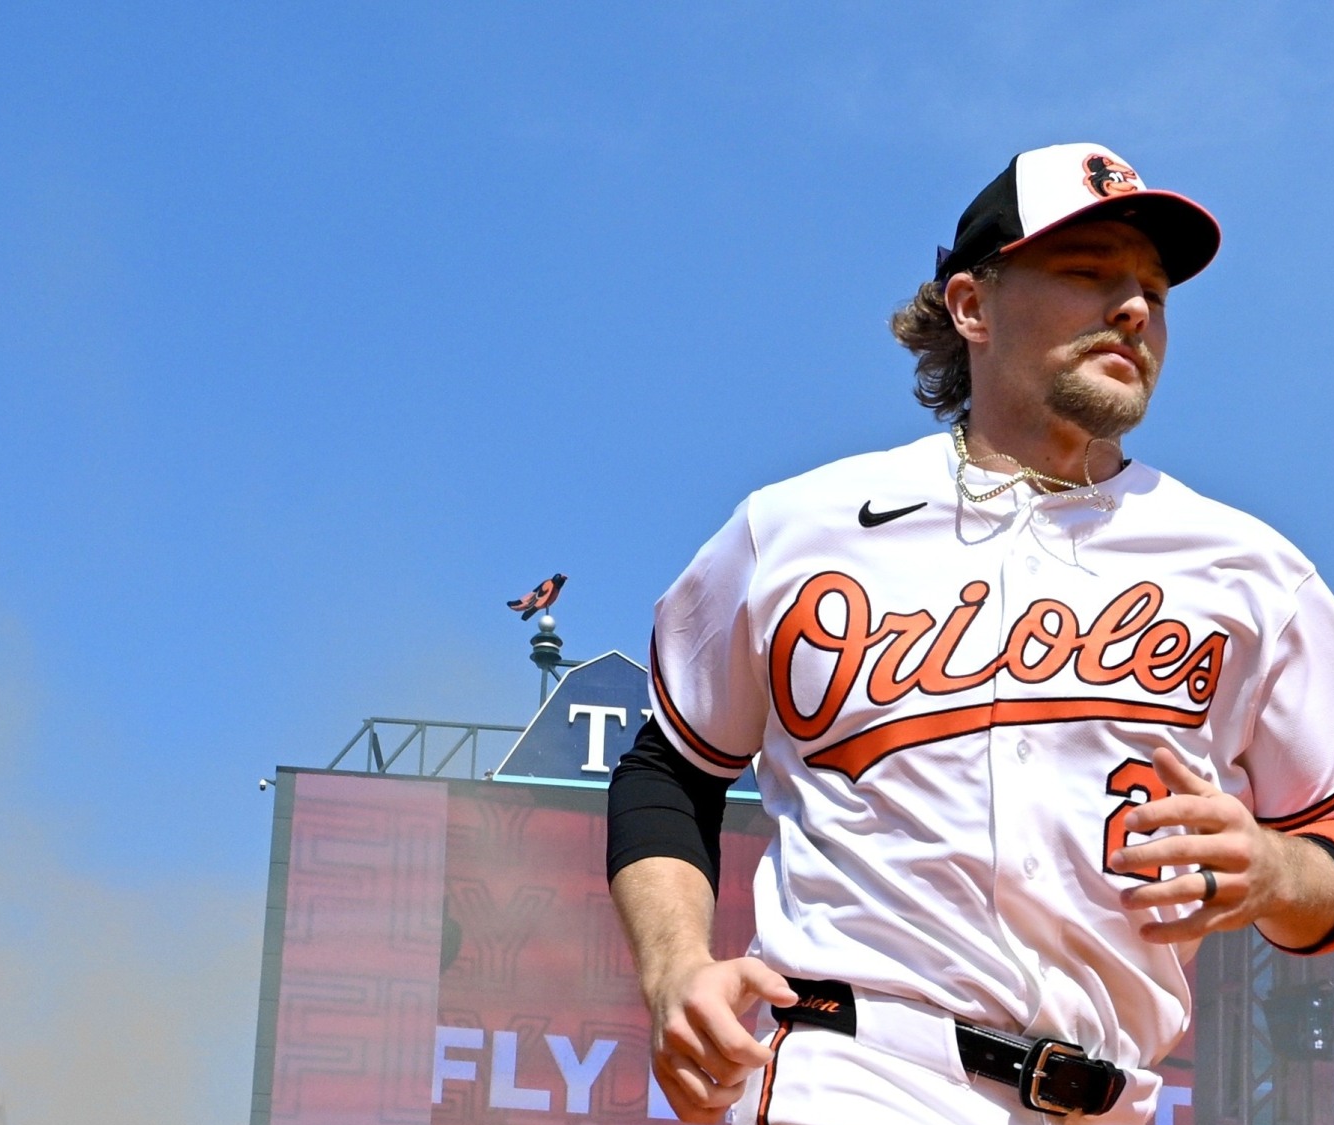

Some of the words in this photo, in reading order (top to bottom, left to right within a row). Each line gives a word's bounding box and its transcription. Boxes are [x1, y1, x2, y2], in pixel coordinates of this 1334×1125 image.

[768, 571, 1229, 742] Orioles
[1102, 757, 1171, 882] 2
[431, 1026, 618, 1115] FLY
